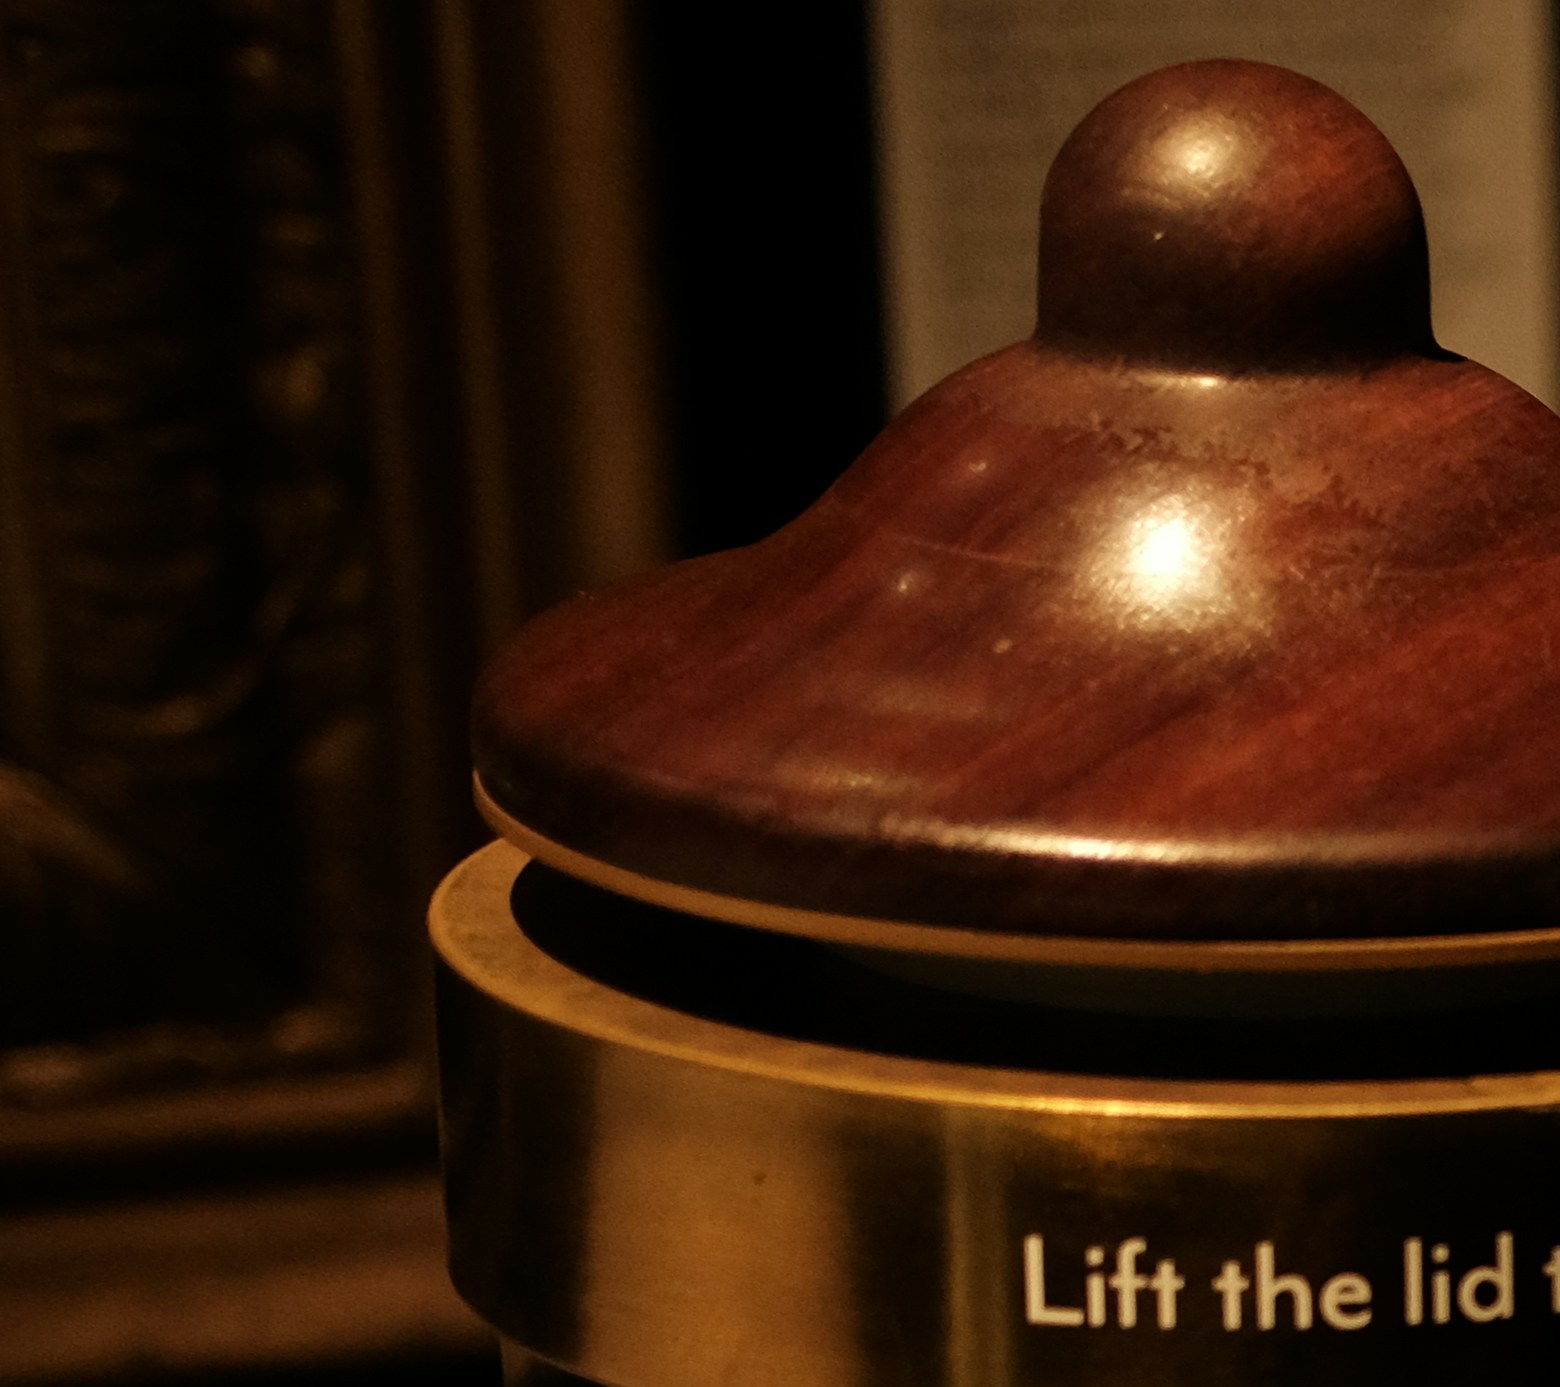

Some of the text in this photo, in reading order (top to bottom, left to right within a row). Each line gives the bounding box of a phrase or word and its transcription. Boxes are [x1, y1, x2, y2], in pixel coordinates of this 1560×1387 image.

[1023, 1233, 1185, 1330] Lift
[1212, 1240, 1373, 1331] the
[1402, 1231, 1515, 1326] lid
